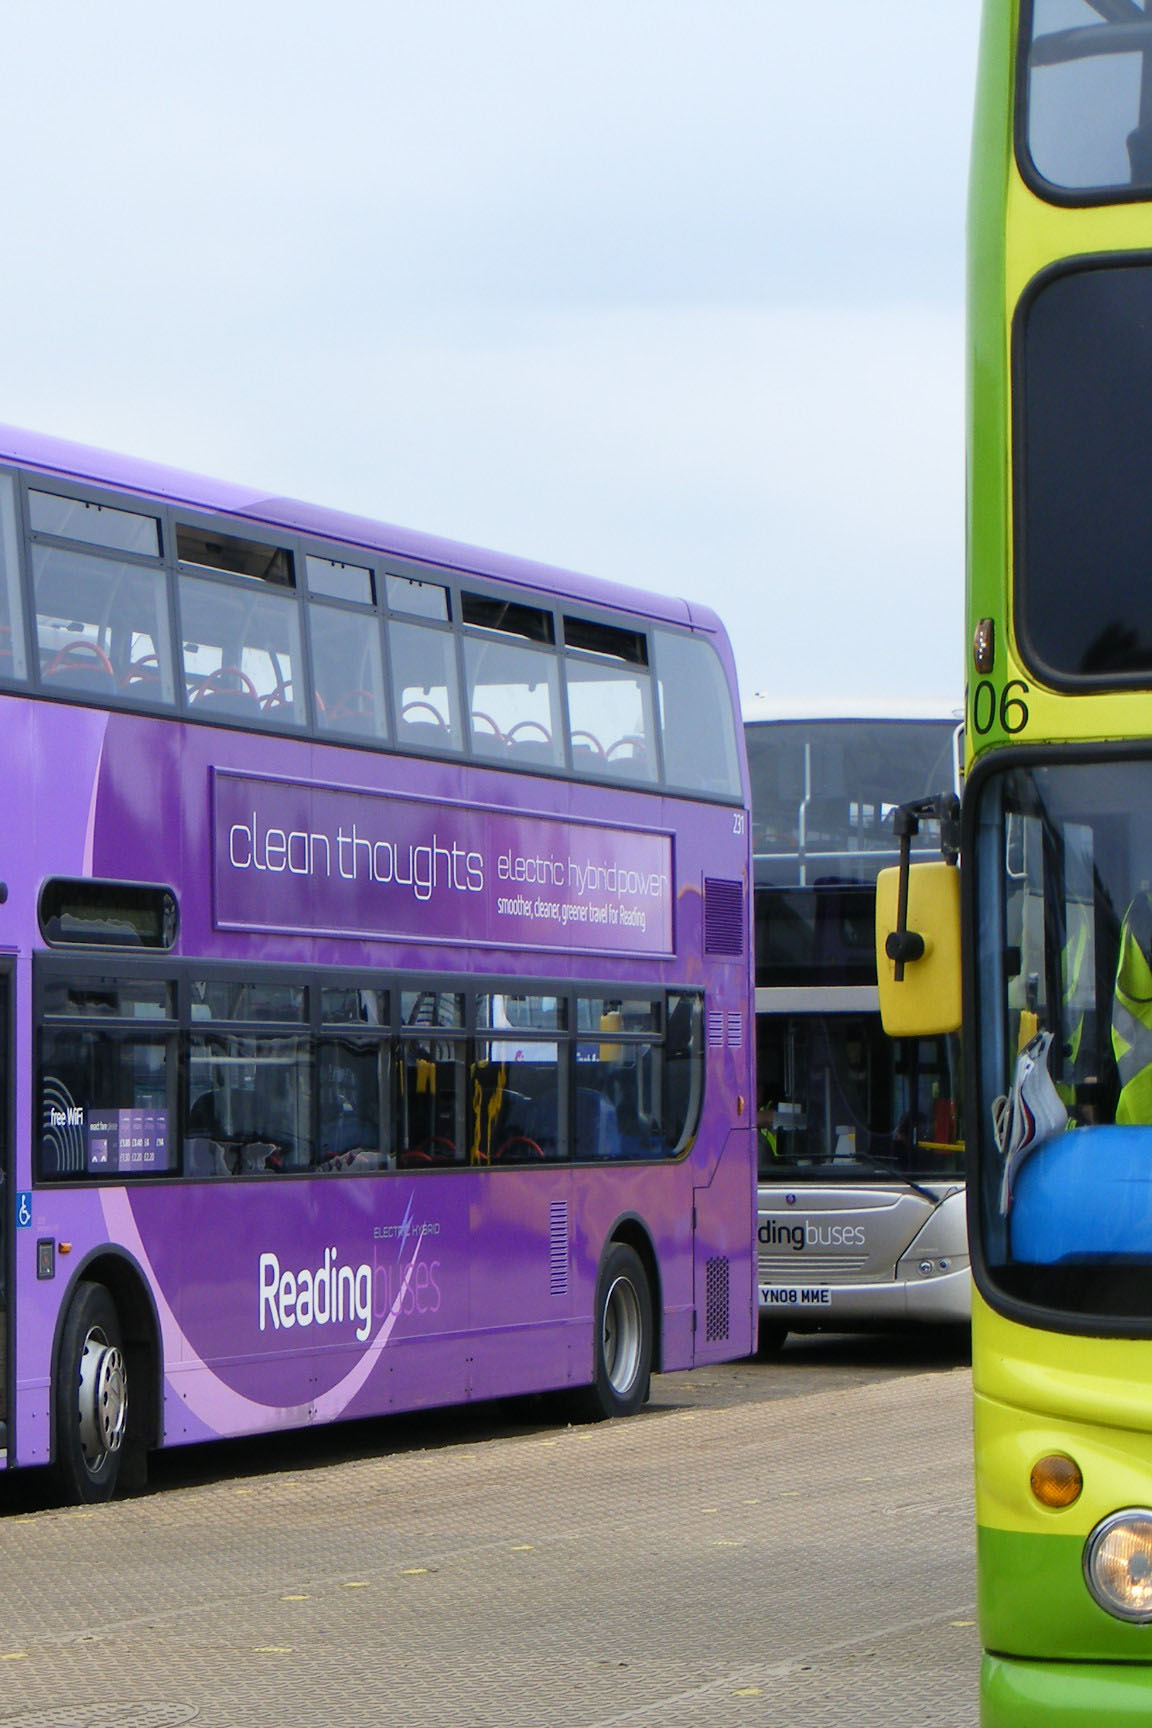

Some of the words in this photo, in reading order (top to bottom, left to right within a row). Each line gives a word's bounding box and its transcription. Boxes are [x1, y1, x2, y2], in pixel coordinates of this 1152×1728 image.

[733, 813, 744, 835] 231
[230, 811, 330, 877] clean
[337, 824, 484, 900] thoughts
[497, 848, 565, 886] electric
[561, 903, 588, 926] greener
[589, 902, 608, 923] travel
[609, 904, 619, 925] for
[620, 905, 646, 932] Reading
[50, 1107, 66, 1126] free
[67, 1107, 84, 1126] WiFi
[373, 1225, 411, 1239] ELECTRC
[761, 1289, 797, 1303] YN08
[801, 1289, 829, 1303] MME
